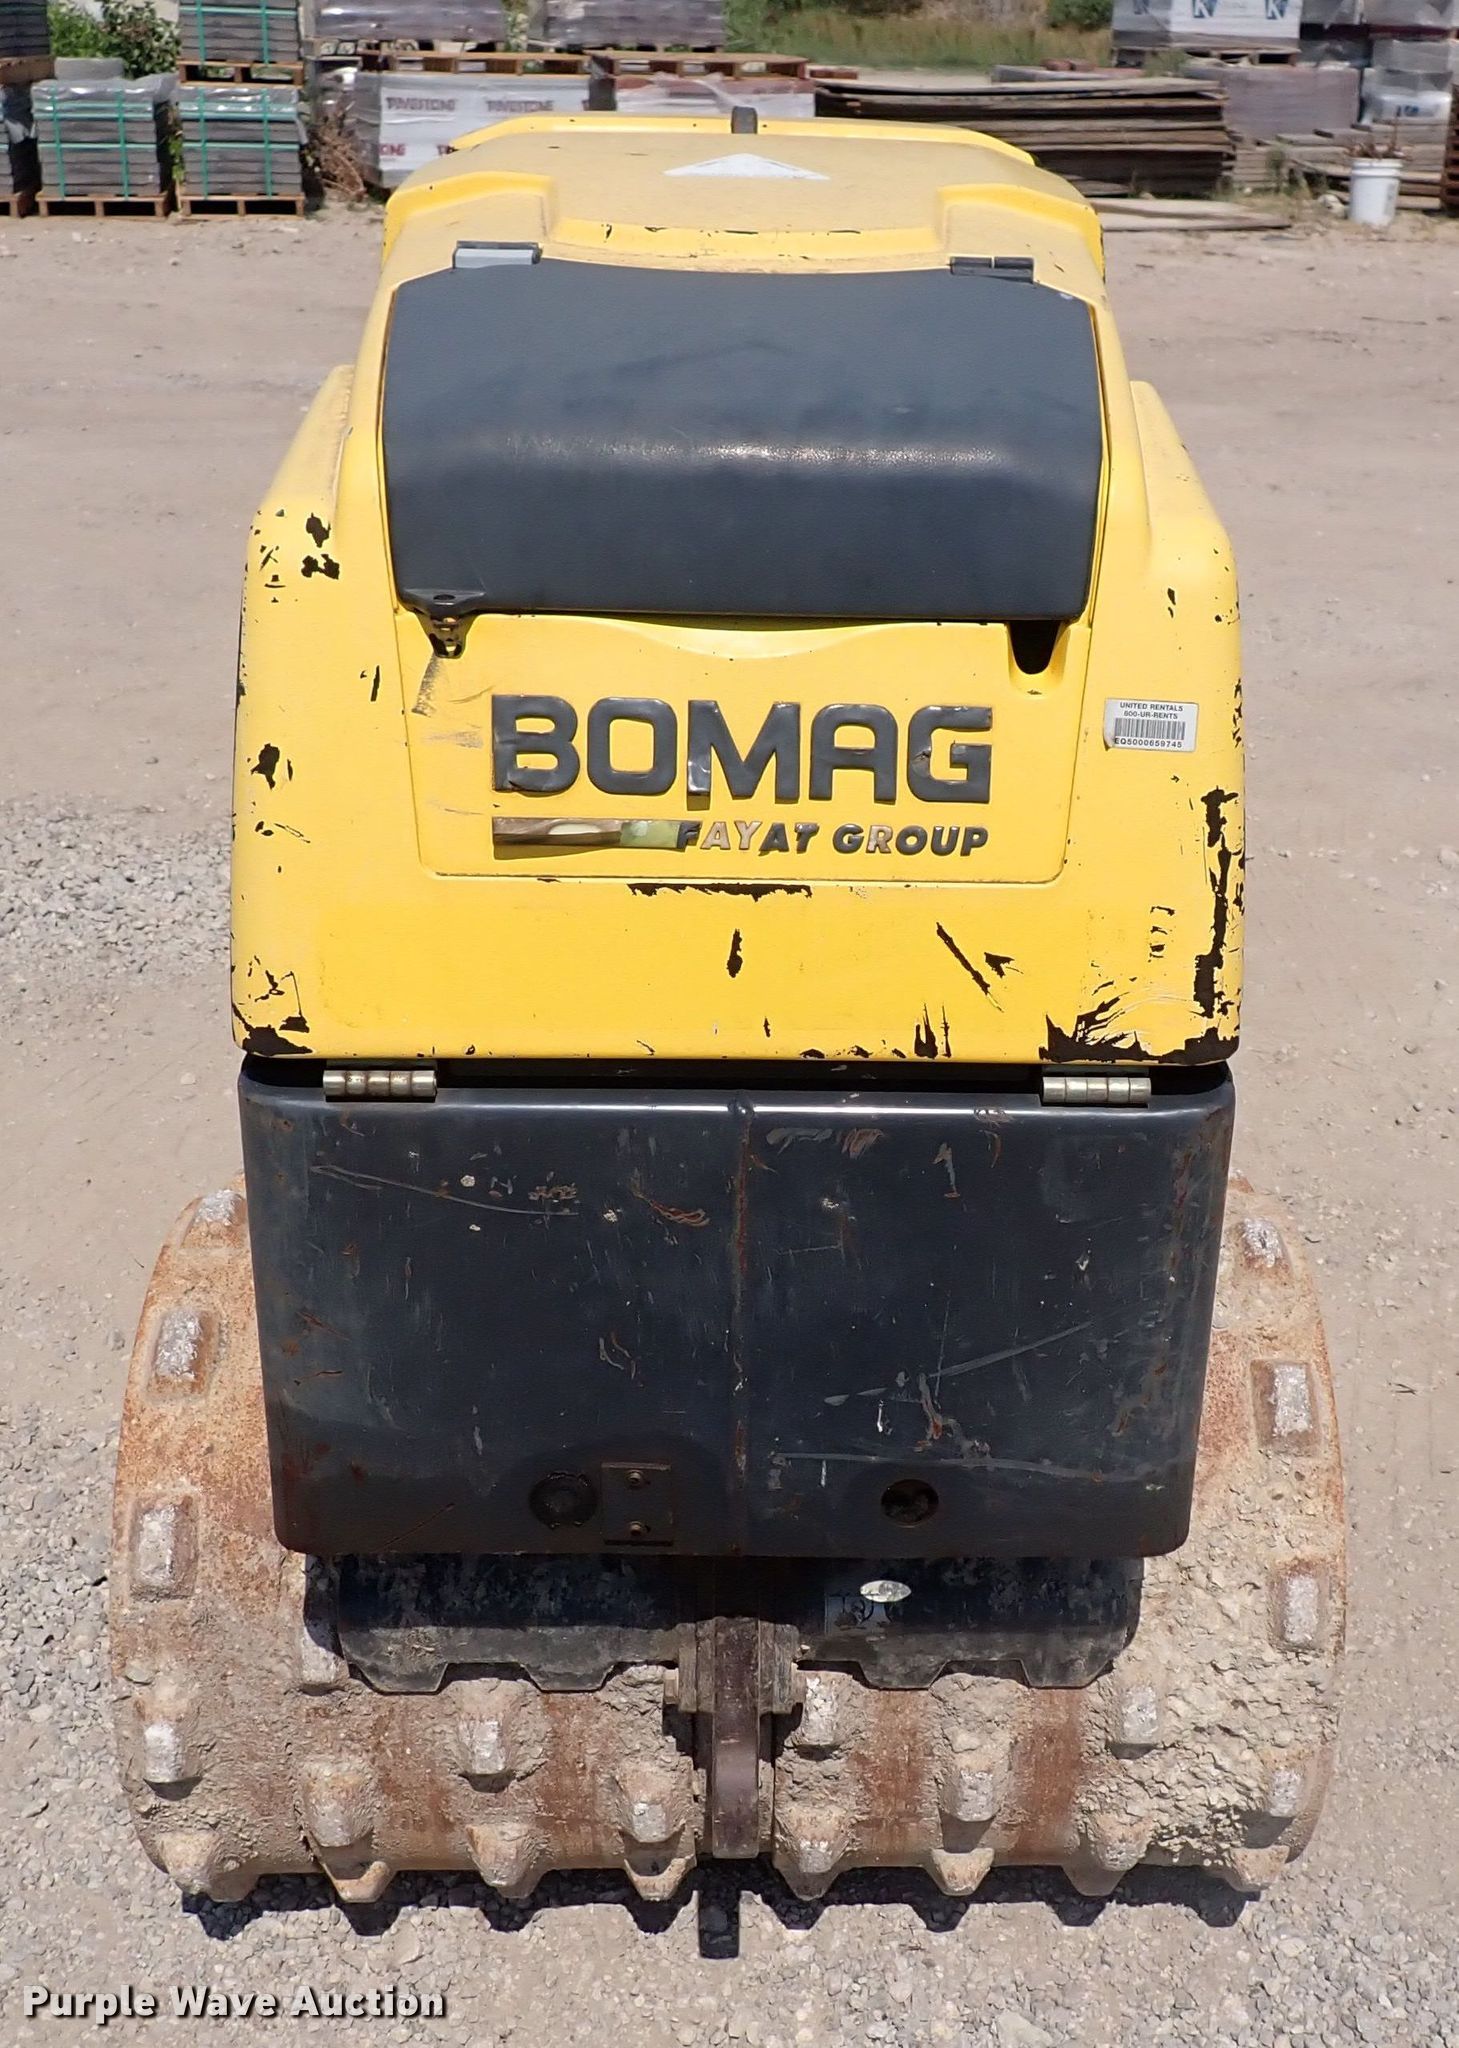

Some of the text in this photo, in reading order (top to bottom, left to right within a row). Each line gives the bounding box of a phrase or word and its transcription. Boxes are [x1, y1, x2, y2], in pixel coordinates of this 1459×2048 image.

[1119, 702, 1184, 712] UNITED RENTALS
[491, 694, 993, 811] BOMAG
[676, 820, 989, 857] FAYAT GROUP
